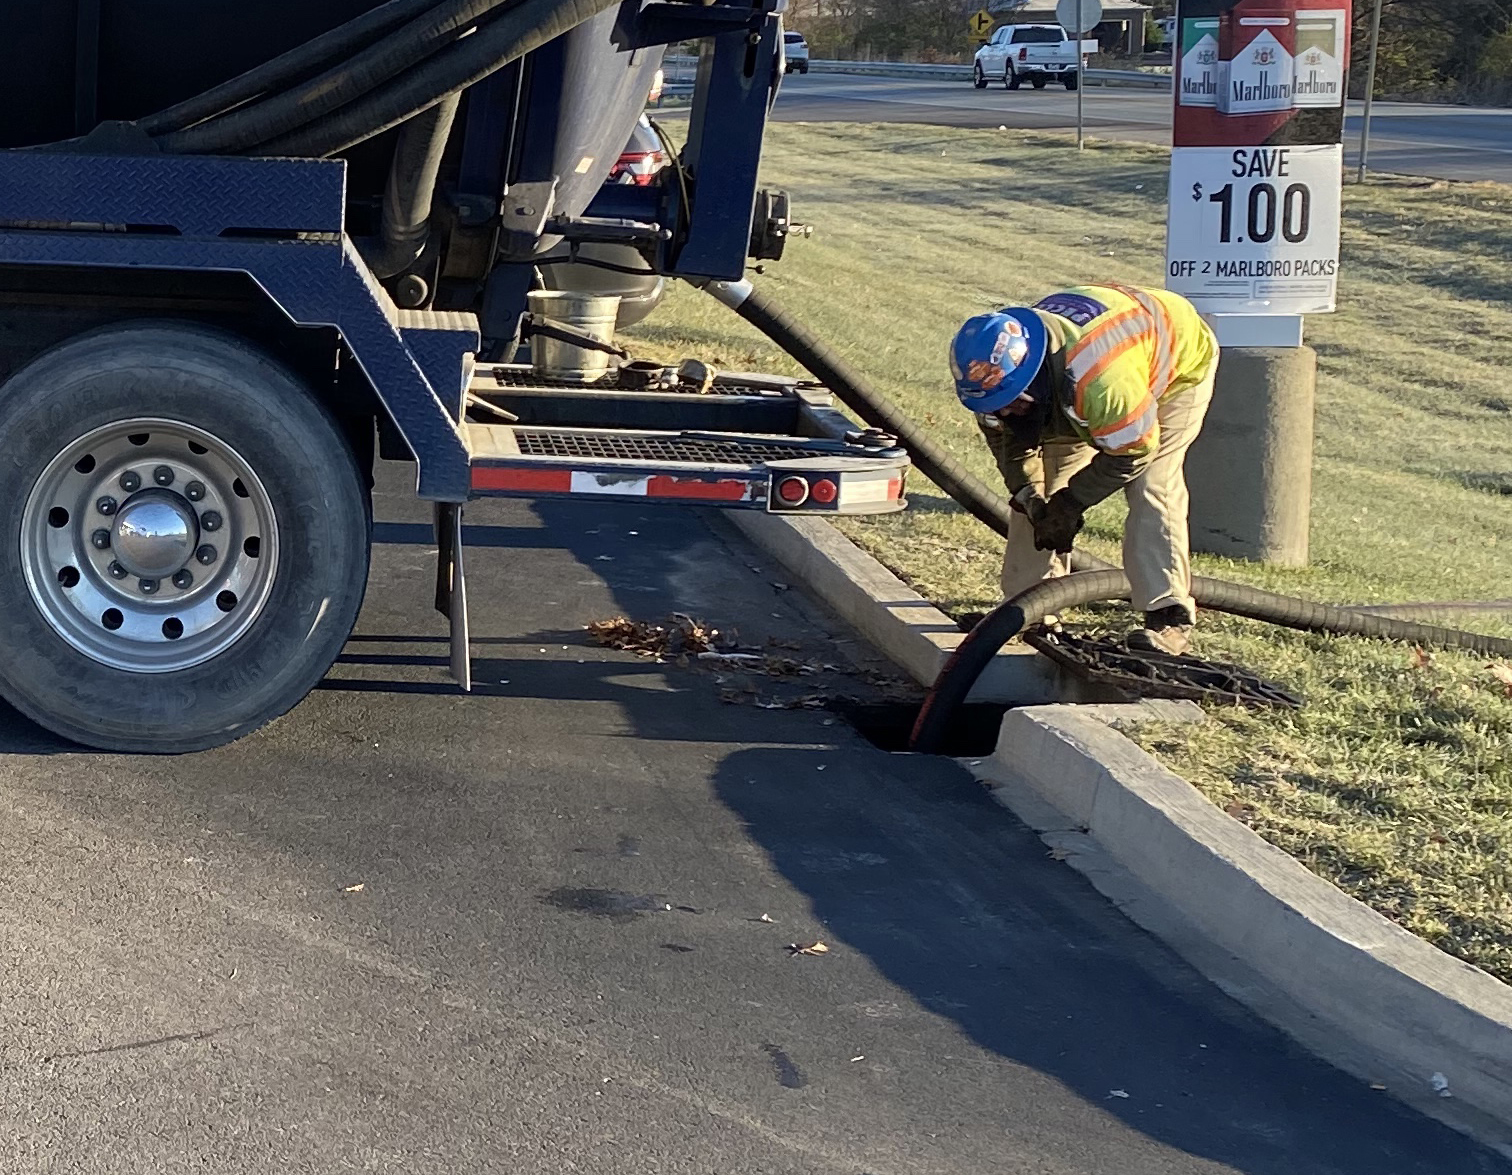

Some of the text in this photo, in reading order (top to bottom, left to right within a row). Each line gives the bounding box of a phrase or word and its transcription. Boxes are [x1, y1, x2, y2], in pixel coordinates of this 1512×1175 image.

[1233, 70, 1291, 102] Marlboro
[1231, 148, 1291, 179] SAVE
[1169, 258, 1336, 278] OFF 2 MARLBORO PACKS
